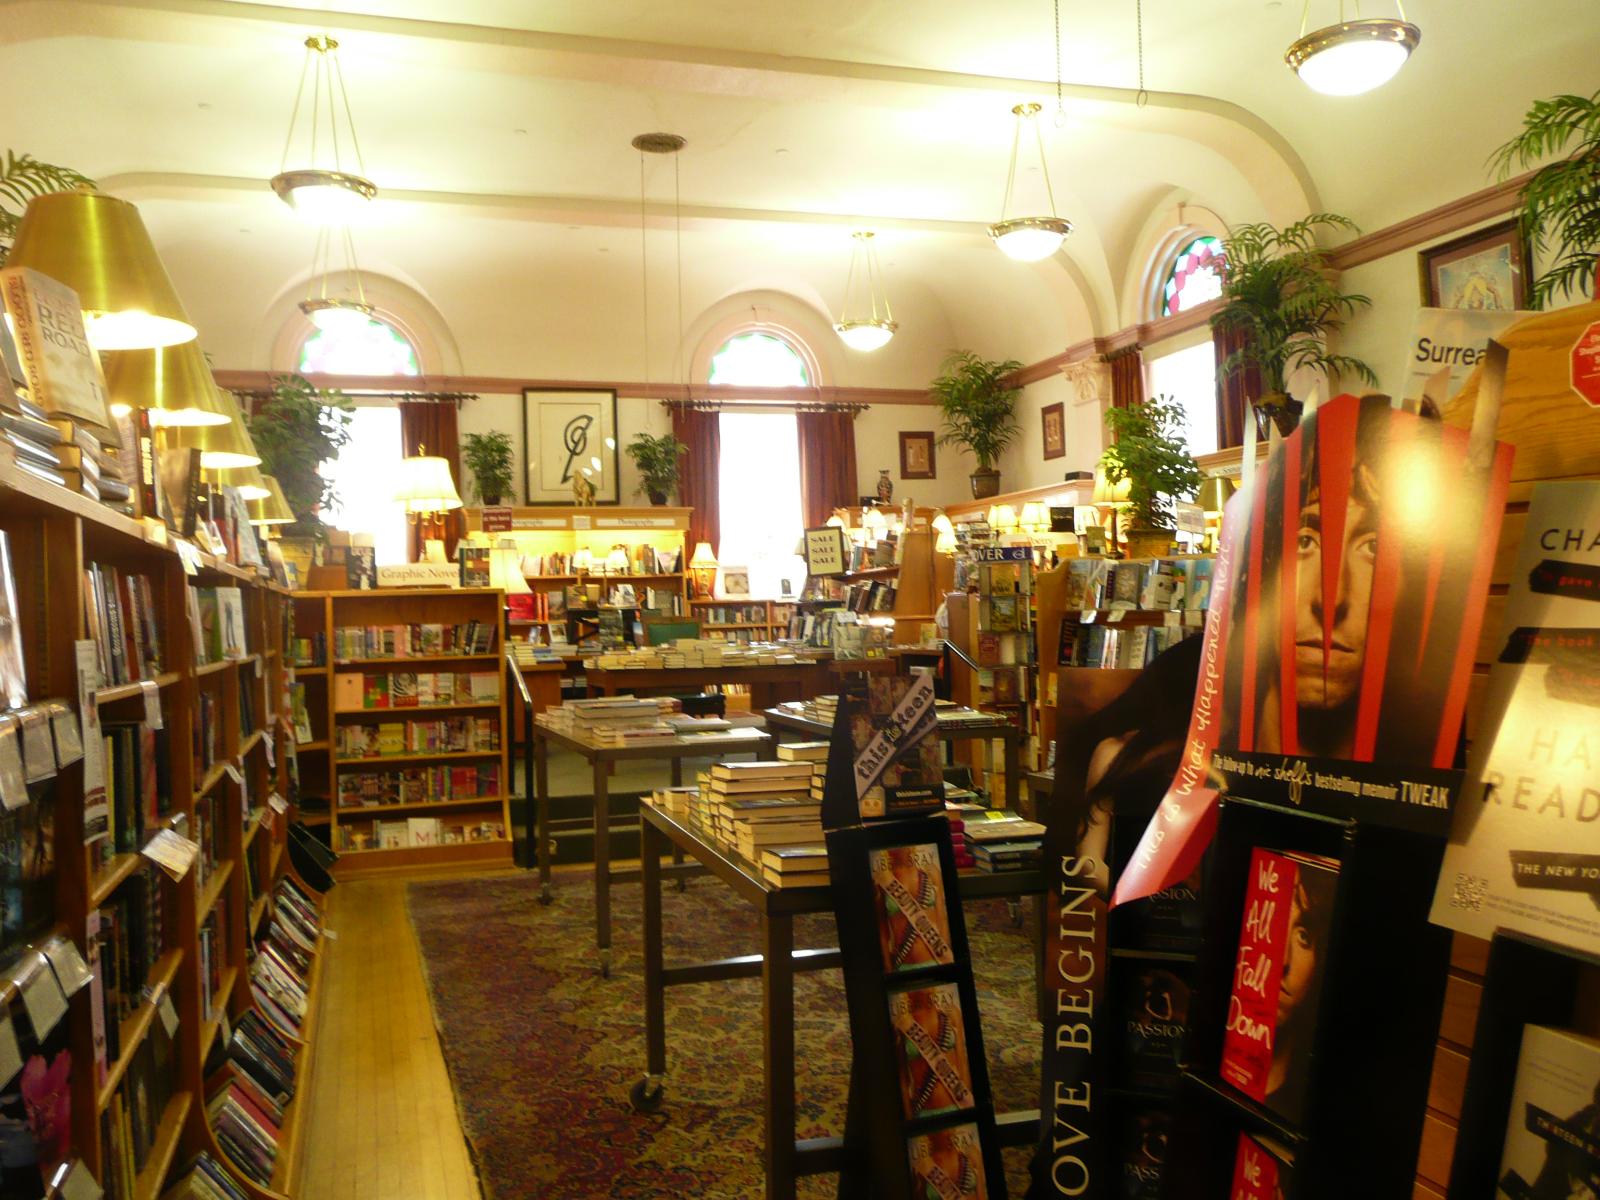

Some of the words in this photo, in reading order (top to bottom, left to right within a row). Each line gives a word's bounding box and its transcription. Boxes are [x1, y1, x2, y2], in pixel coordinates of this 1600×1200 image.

[41, 325, 91, 359] ROAD
[812, 546, 834, 554] SALE
[381, 567, 425, 581] Graphic
[1176, 740, 1207, 797] What
[1197, 609, 1223, 732] Happened
[858, 742, 890, 779] this
[1314, 772, 1360, 797] bestselling
[1362, 782, 1398, 800] memoir
[1400, 780, 1449, 809] TWEAK
[1483, 770, 1600, 823] READ
[1259, 859, 1279, 893] We
[1517, 862, 1540, 876] THE
[1546, 865, 1576, 878] NEW
[887, 879, 921, 917] BEAUTY
[915, 914, 949, 959] QUEENS
[1246, 899, 1276, 944] All
[1056, 855, 1099, 1054] BEGINS
[1236, 945, 1272, 998] Fall
[1225, 995, 1272, 1050] Down
[906, 1023, 940, 1060] BEAUTY
[935, 1057, 969, 1101] QUEENS
[1052, 1081, 1092, 1197] OVE
[1244, 1148, 1261, 1188] We
